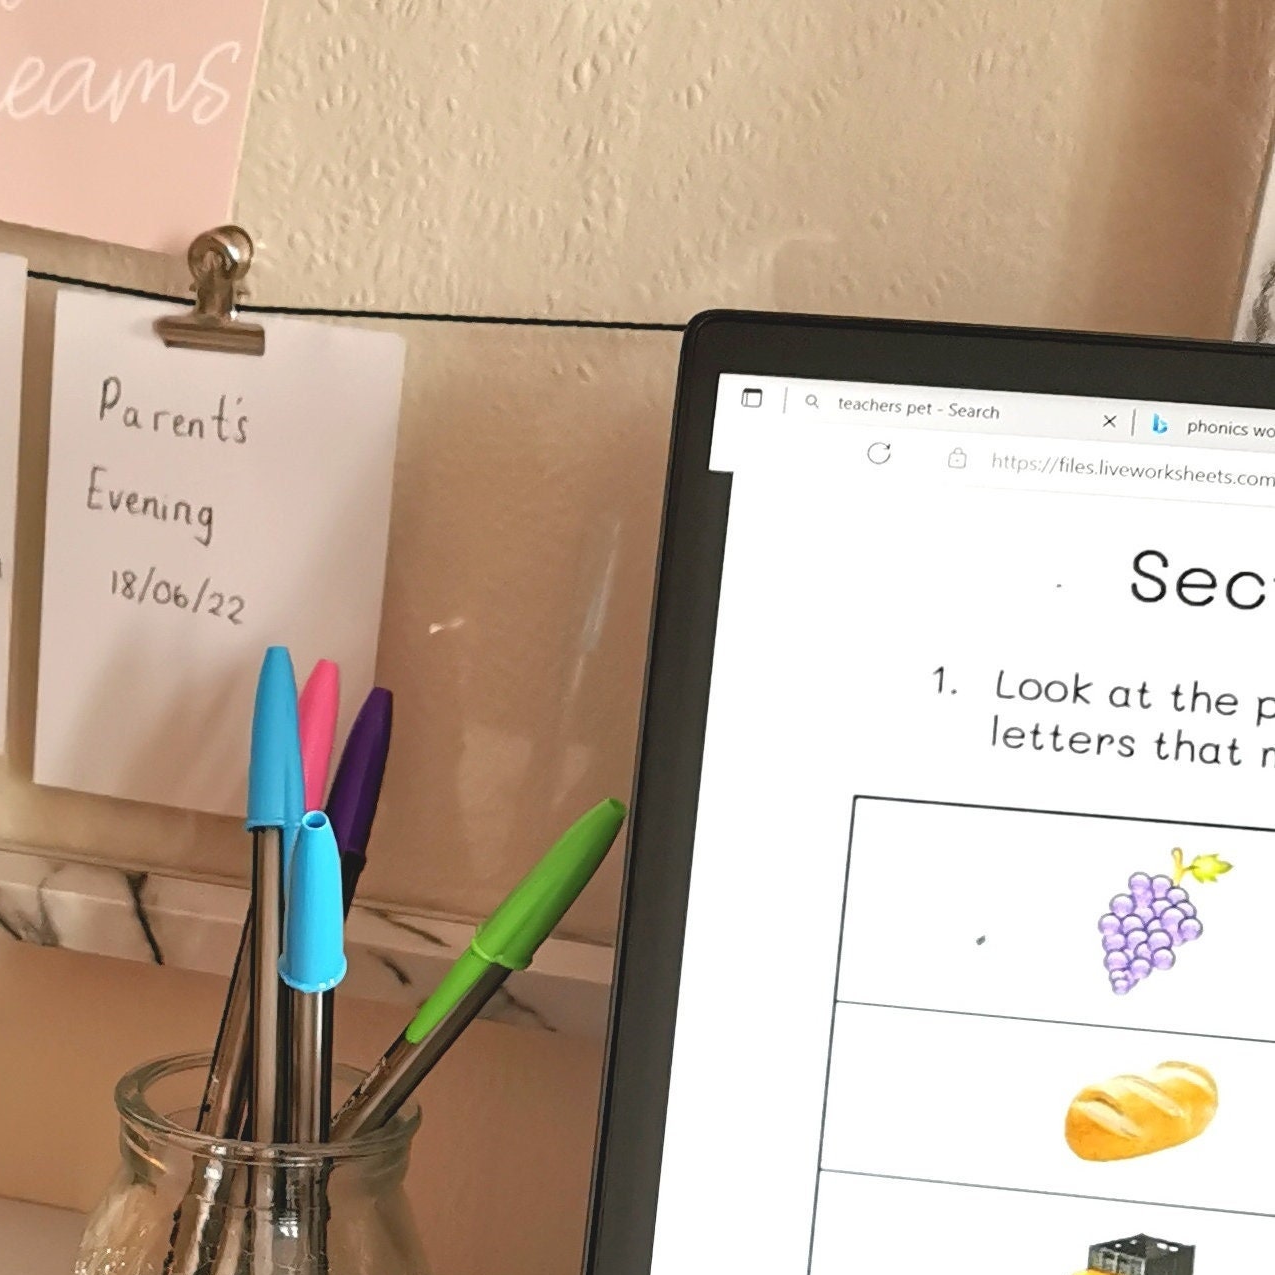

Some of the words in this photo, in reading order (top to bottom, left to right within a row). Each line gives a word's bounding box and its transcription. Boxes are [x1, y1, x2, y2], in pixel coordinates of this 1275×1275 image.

[99, 375, 250, 444] Parent's
[837, 397, 903, 414] teachers
[906, 402, 933, 418] pet
[948, 402, 1001, 420] Search
[1187, 419, 1249, 437] phonics
[86, 463, 215, 548] Evening
[111, 566, 246, 626] 18/06/22
[1131, 549, 1275, 611] Sec
[932, 666, 958, 695] 1.
[996, 669, 1094, 705] Look
[1108, 680, 1153, 710] at
[1170, 680, 1240, 716] the
[991, 714, 1136, 758] letters
[1154, 729, 1243, 767] that
